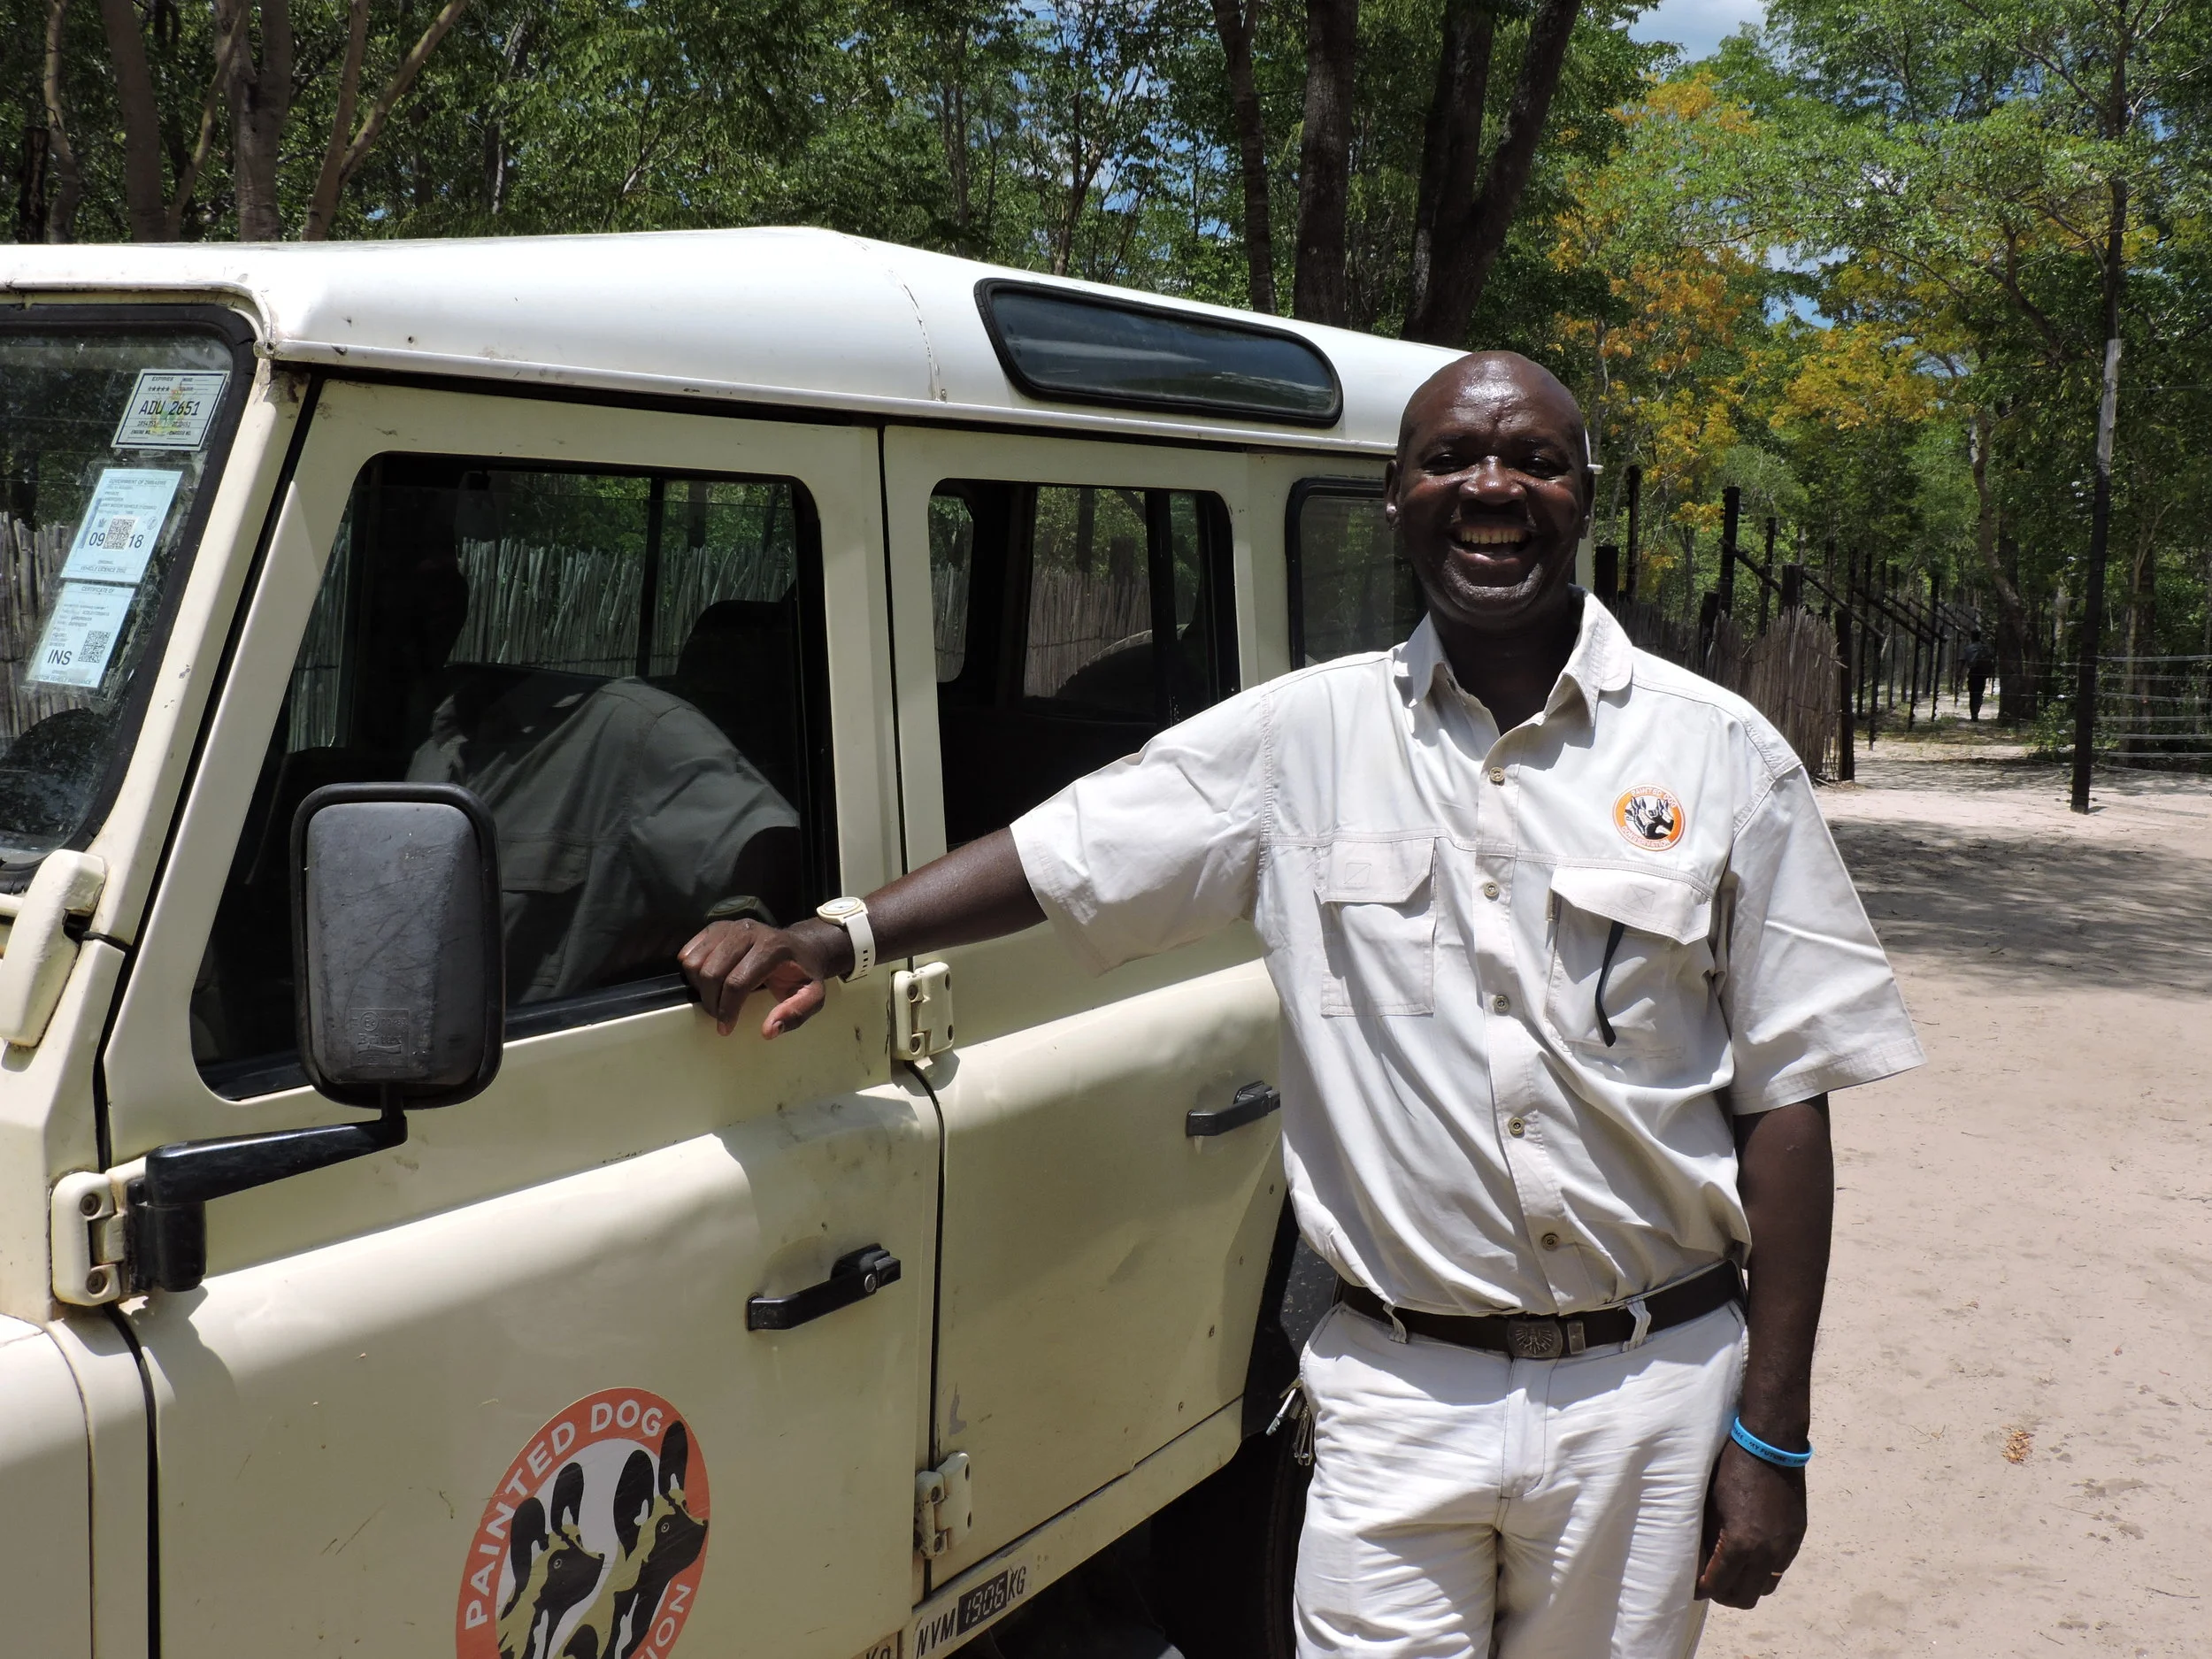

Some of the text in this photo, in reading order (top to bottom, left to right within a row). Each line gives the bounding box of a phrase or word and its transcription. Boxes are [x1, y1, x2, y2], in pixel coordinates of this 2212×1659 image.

[139, 399, 201, 416] ADU 2651
[88, 532, 144, 549] 09 18
[47, 649, 73, 666] INS
[1631, 787, 1678, 808] PAINTED DOG
[1621, 826, 1671, 848] CONSERVATION
[465, 1399, 664, 1630] PAINTED DOG
[639, 1583, 692, 1659] ION
[917, 1564, 1027, 1659] NVM 1906 KG
